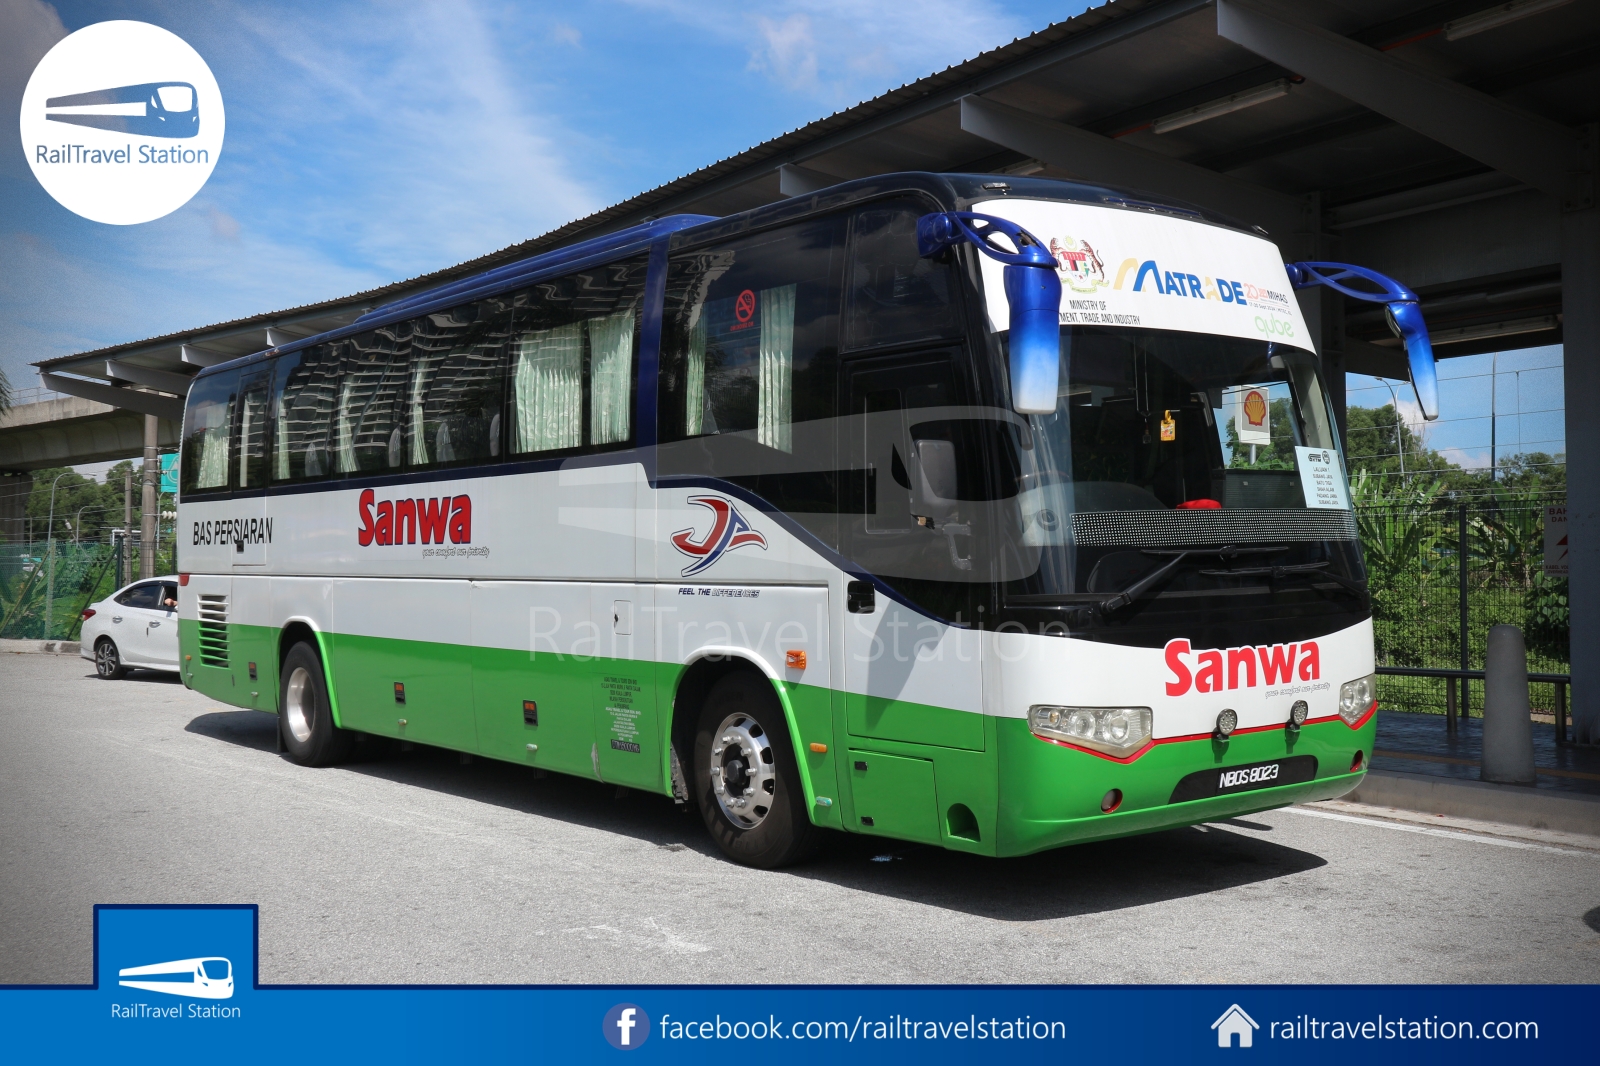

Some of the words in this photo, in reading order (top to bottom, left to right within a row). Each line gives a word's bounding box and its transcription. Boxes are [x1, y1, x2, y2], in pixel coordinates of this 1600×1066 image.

[1113, 258, 1247, 306] MATRADE
[1266, 290, 1289, 304] MIHAS
[1069, 299, 1098, 310] MINISTRY
[1099, 300, 1107, 311] OF
[1059, 312, 1080, 323] MENT,
[1080, 312, 1099, 323] TRADE
[1100, 313, 1114, 324] AND
[1114, 314, 1141, 325] INDUSTRY
[1254, 312, 1294, 339] qube
[358, 488, 472, 547] Sanwa
[193, 521, 212, 546] BAS
[213, 517, 273, 546] PERSIARAN
[422, 548, 435, 559] your
[456, 548, 467, 556] our
[678, 588, 695, 596] FEEL
[698, 588, 711, 596] THE
[712, 588, 761, 598] DIFFERENCES
[1164, 639, 1320, 697] Sanwa
[1265, 689, 1279, 699] your
[1301, 685, 1311, 693] our
